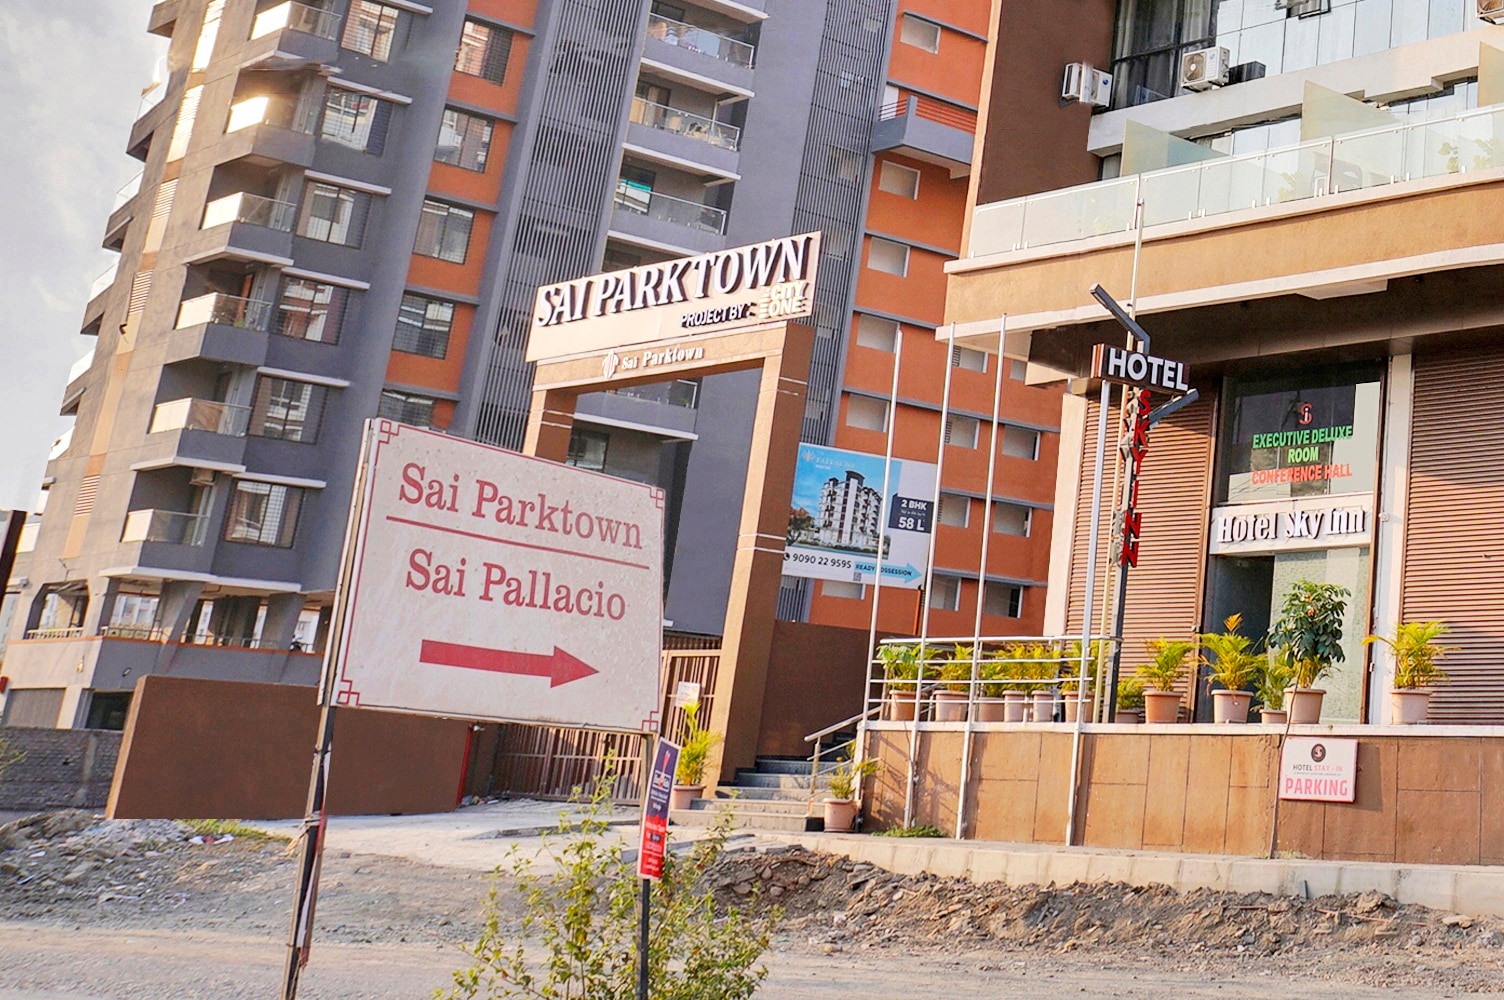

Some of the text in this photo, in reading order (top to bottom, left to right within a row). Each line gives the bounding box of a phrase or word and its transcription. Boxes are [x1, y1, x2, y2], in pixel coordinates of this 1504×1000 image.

[536, 236, 812, 327] SAI PARKTOWN
[771, 280, 807, 300] CITY
[682, 306, 729, 328] PROJECT
[768, 296, 804, 317] ONE
[621, 346, 703, 370] Sai Parktown
[1108, 347, 1189, 391] HOTEL
[1252, 425, 1353, 449] EXECUTIVE DELUXE
[1287, 446, 1319, 463] ROOM
[1251, 463, 1353, 485] CONFERENCE HALL
[399, 462, 643, 550] Sai Parktown
[901, 499, 927, 510] 2 BHK
[898, 517, 914, 529] 58
[1216, 508, 1365, 543] Hotel Sky Inn
[792, 553, 852, 569] 9090 22 9595
[855, 564, 912, 576] READY OSSESSION
[405, 548, 626, 620] Sai Pallacio
[1292, 764, 1313, 772] HOTEL
[1285, 777, 1348, 796] PARKING
